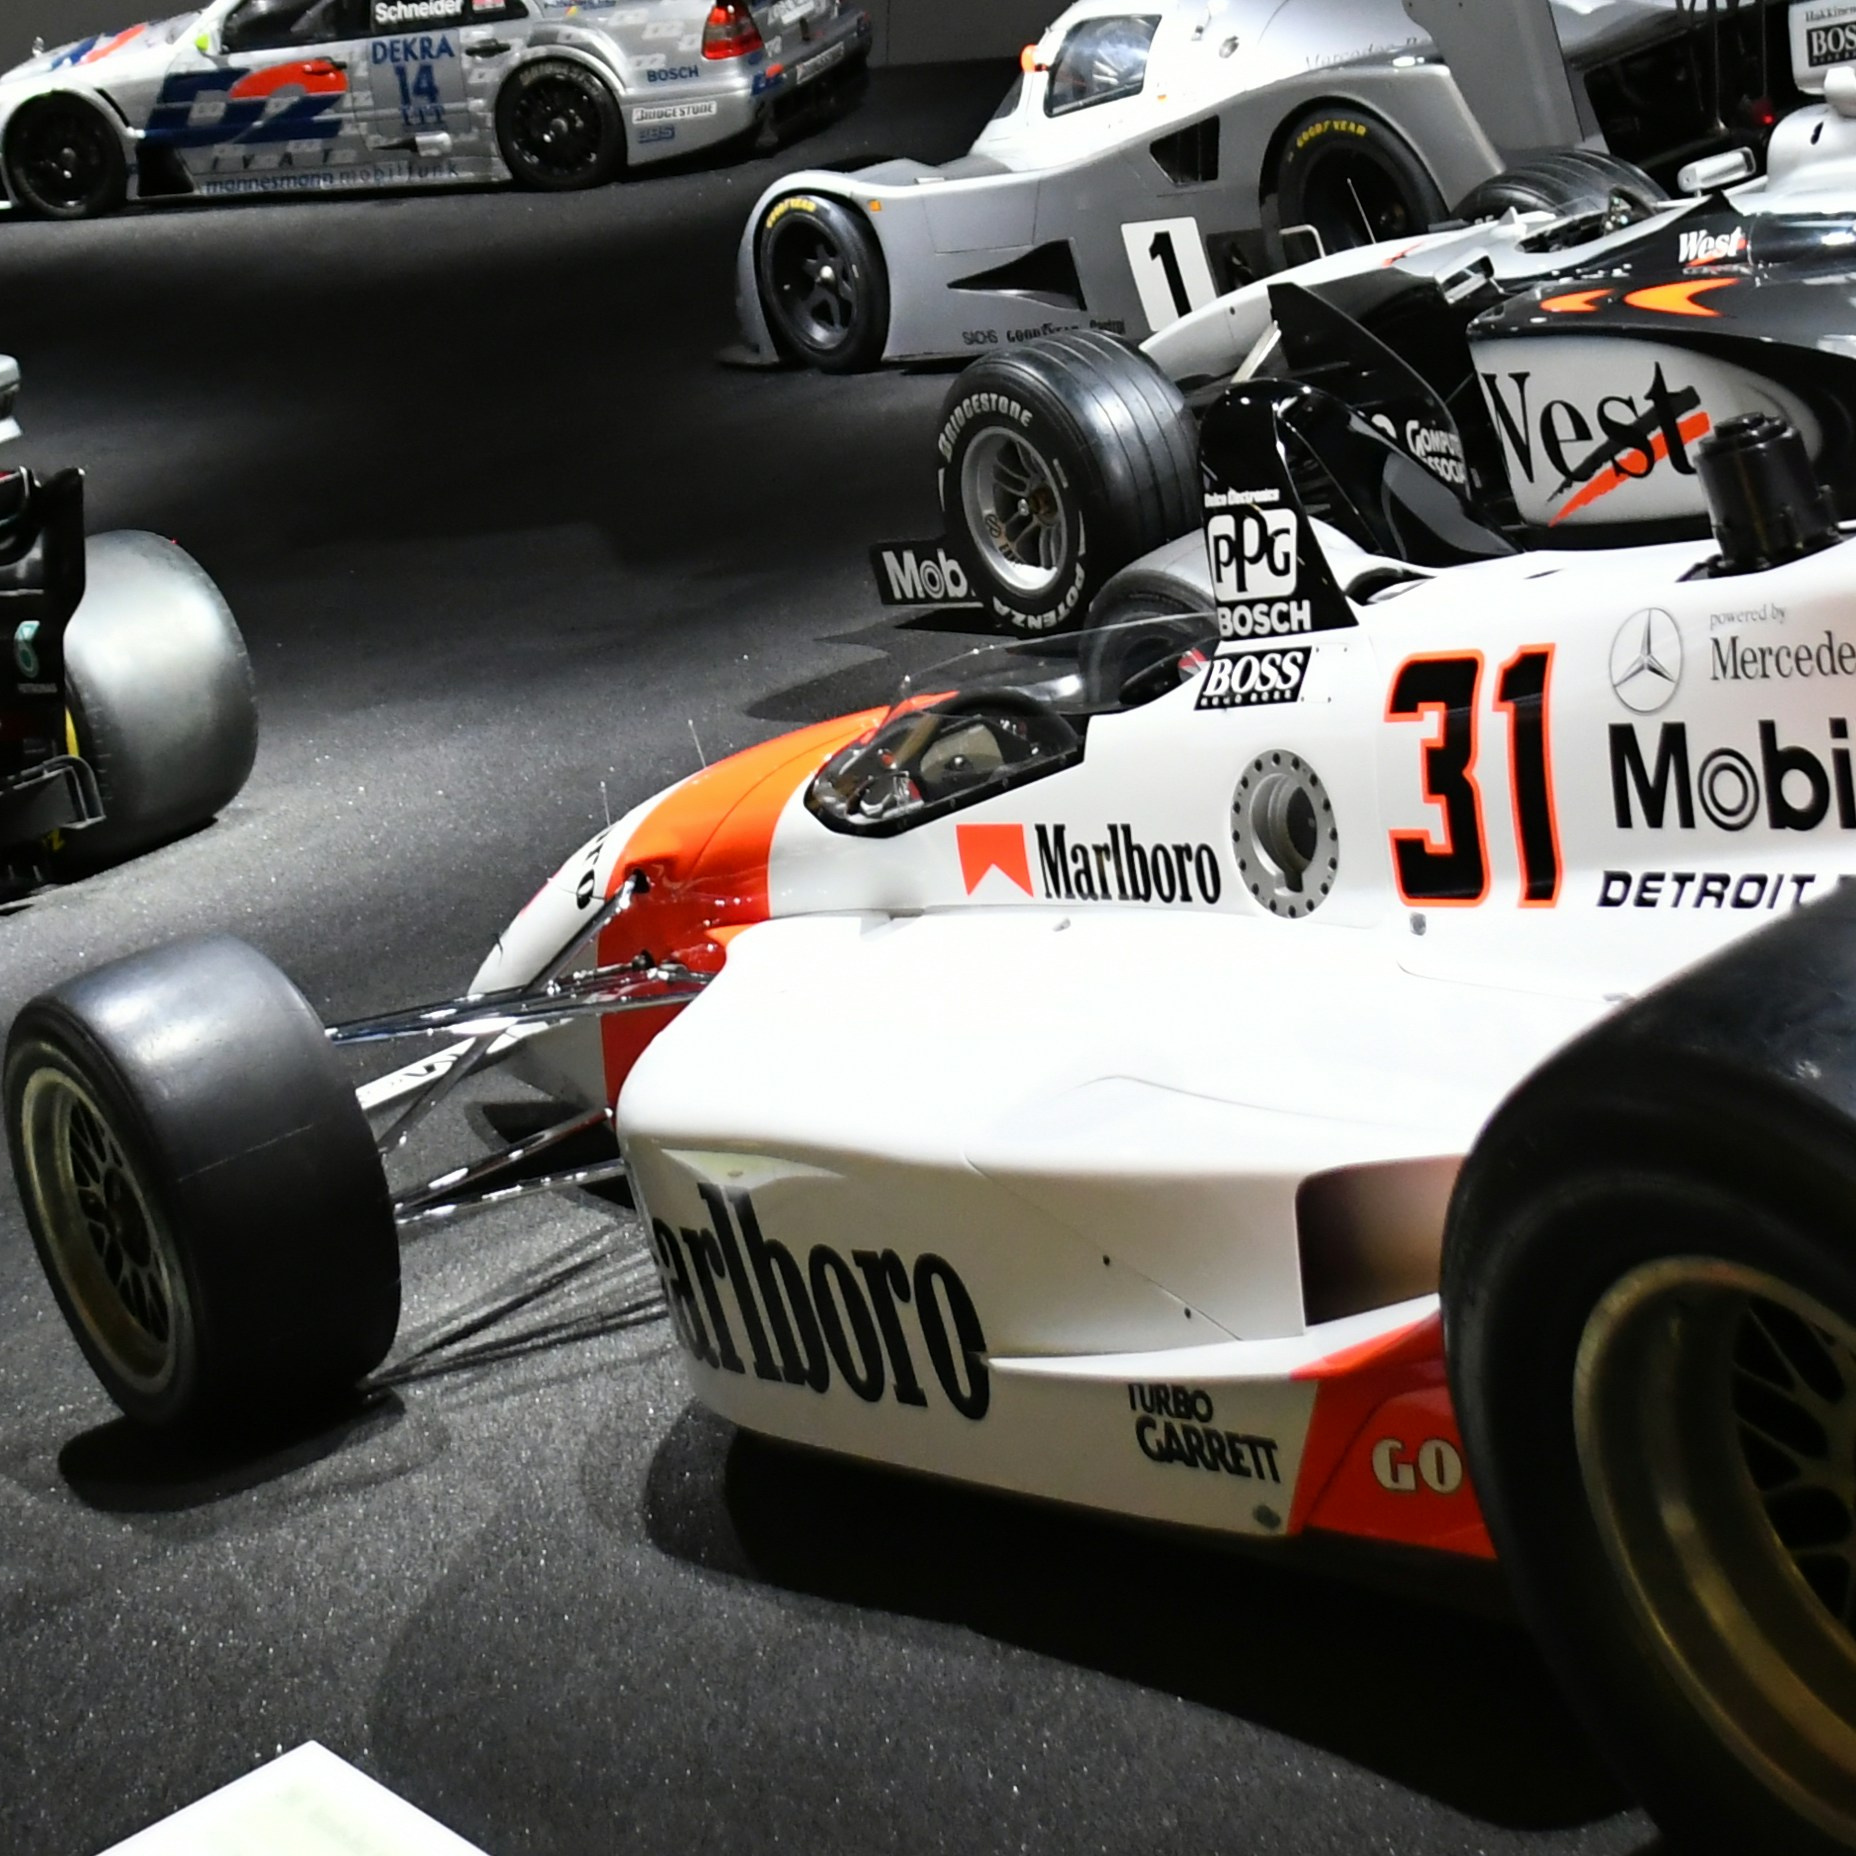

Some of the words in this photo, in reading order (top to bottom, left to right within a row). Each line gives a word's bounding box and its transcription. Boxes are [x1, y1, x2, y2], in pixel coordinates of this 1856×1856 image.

[370, 34, 456, 66] DEKRA
[393, 64, 441, 109] 14
[646, 65, 699, 83] BOSCH
[633, 101, 716, 123] BRIDGESTONE
[204, 172, 334, 195] mannesmann
[339, 161, 460, 186] mobilfunk
[1678, 225, 1744, 263] West
[1148, 230, 1194, 319] 1
[961, 327, 999, 345] SACHS
[938, 392, 1034, 463] BRIDGESTONE
[881, 547, 977, 601] Mob
[992, 562, 1085, 630] POTENZA
[1216, 599, 1313, 638] BOSCH
[1709, 604, 1764, 629] powered
[1766, 601, 1787, 626] by
[1202, 650, 1305, 696] BOSS
[1384, 642, 1564, 909] 31
[1034, 822, 1222, 906] Marlboro
[1597, 869, 1815, 909] DETROIT
[652, 1180, 993, 1422] arlboro
[1127, 1381, 1215, 1424] TURBO
[1134, 1415, 1283, 1485] GARRETT
